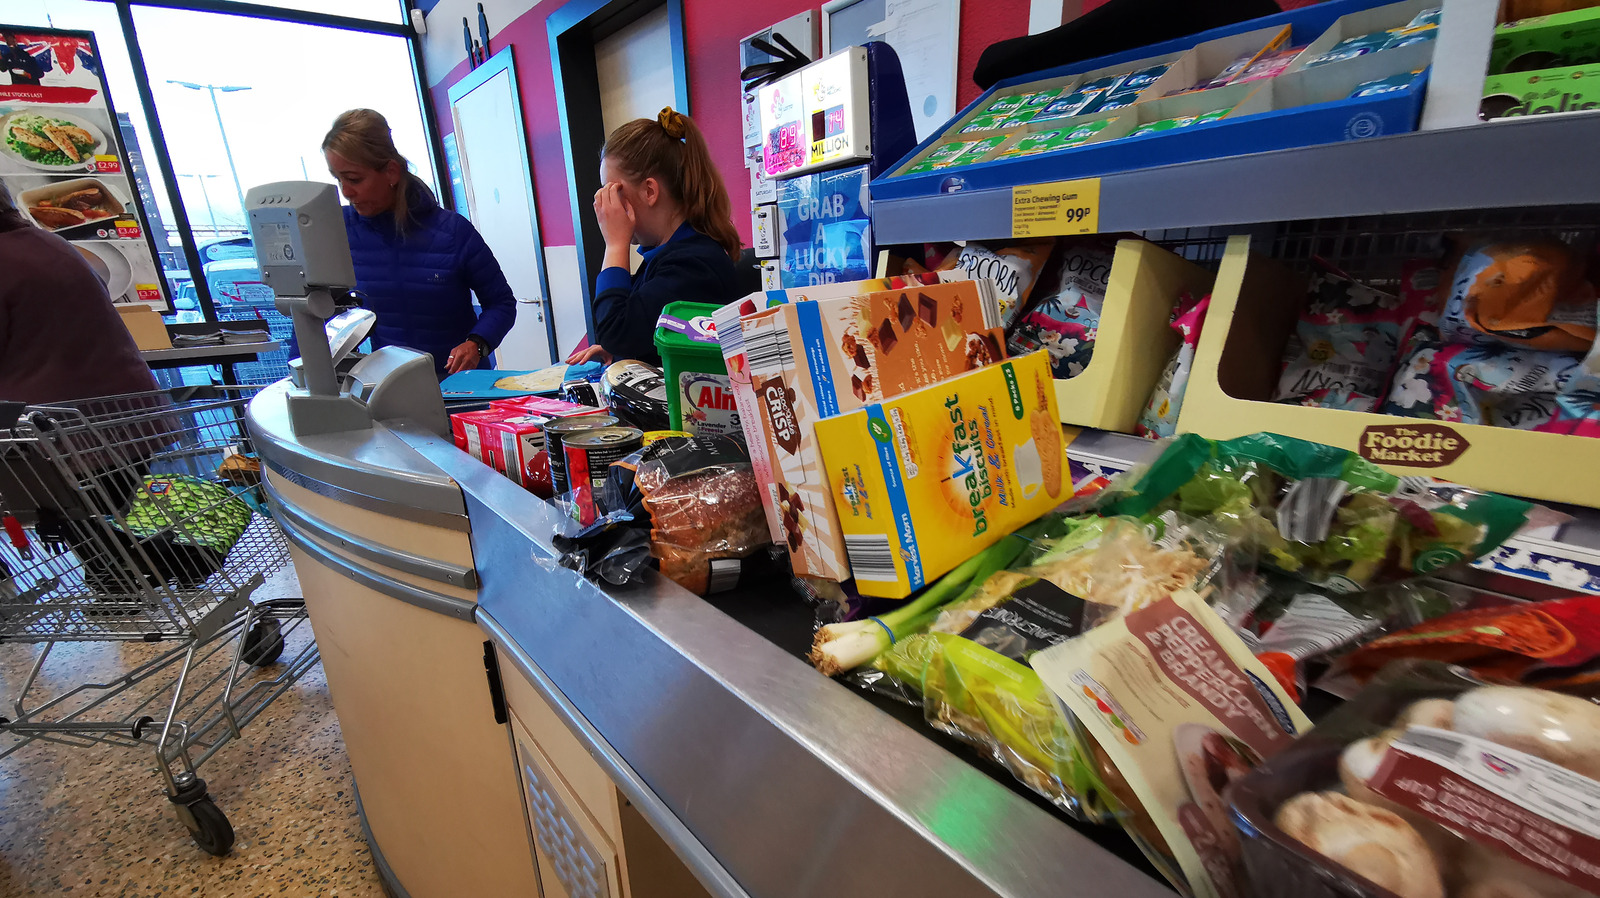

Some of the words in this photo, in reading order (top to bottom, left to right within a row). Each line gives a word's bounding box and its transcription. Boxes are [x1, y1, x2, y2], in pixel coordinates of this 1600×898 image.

[828, 109, 844, 133] 14
[811, 135, 849, 158] MILLION
[798, 194, 844, 221] GRAB
[1032, 194, 1060, 203] Chewing
[815, 222, 824, 244] A
[794, 246, 850, 271] LUCKY
[766, 386, 791, 442] CRISP
[977, 405, 995, 450] Cereal
[994, 428, 1009, 466] breakfast
[1364, 432, 1459, 450] Foodie
[1394, 428, 1419, 436] The
[944, 393, 988, 538] breakfast
[965, 418, 992, 500] biscuits
[987, 450, 1001, 470] &
[1369, 448, 1444, 462] Market
[993, 473, 1009, 506] Milk
[901, 513, 914, 543] Morn
[908, 544, 922, 585] Harvest
[1170, 616, 1248, 686] CREAMY
[1144, 631, 1162, 648] &
[1160, 648, 1246, 718] BRANDY
[1156, 624, 1280, 740] PEPPERCORN
